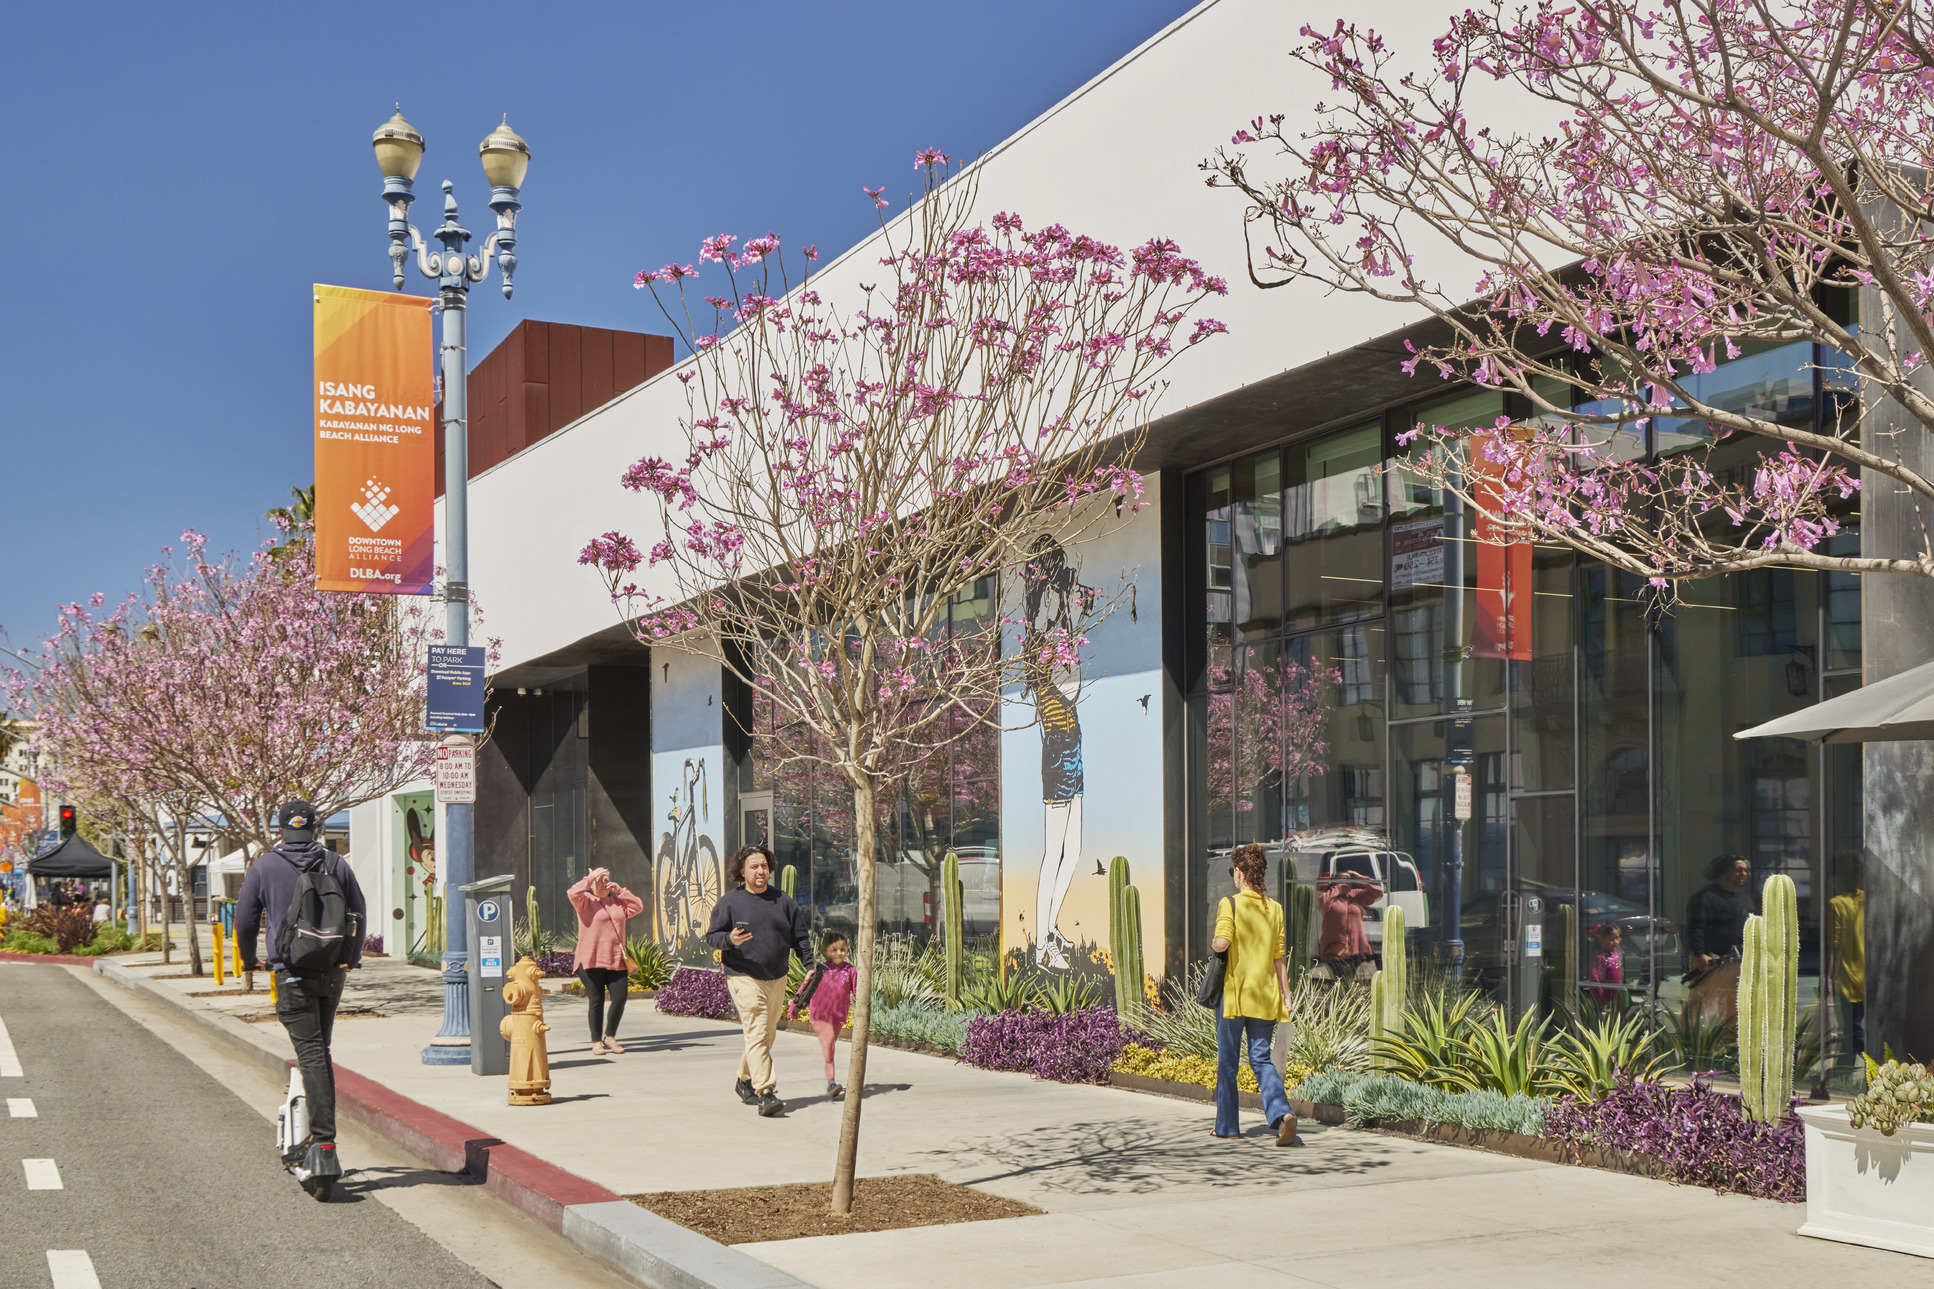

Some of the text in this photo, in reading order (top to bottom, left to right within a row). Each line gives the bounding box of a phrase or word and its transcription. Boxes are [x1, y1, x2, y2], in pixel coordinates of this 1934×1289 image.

[319, 380, 376, 400] ISANG
[319, 398, 430, 421] KABAYANAN
[319, 419, 422, 434] KABAYANAN NG LONG
[319, 430, 399, 444] BEACH ALLIANCE
[348, 536, 402, 547] DOWNTOWN
[348, 545, 402, 555] LONG BEACH
[348, 553, 402, 562] ALLIANCE
[349, 567, 402, 584] DLBA.org
[443, 656, 463, 664] PARK
[437, 748, 472, 759] NO PARKING
[439, 781, 472, 789] WEDNESDAY
[483, 903, 496, 920] P
